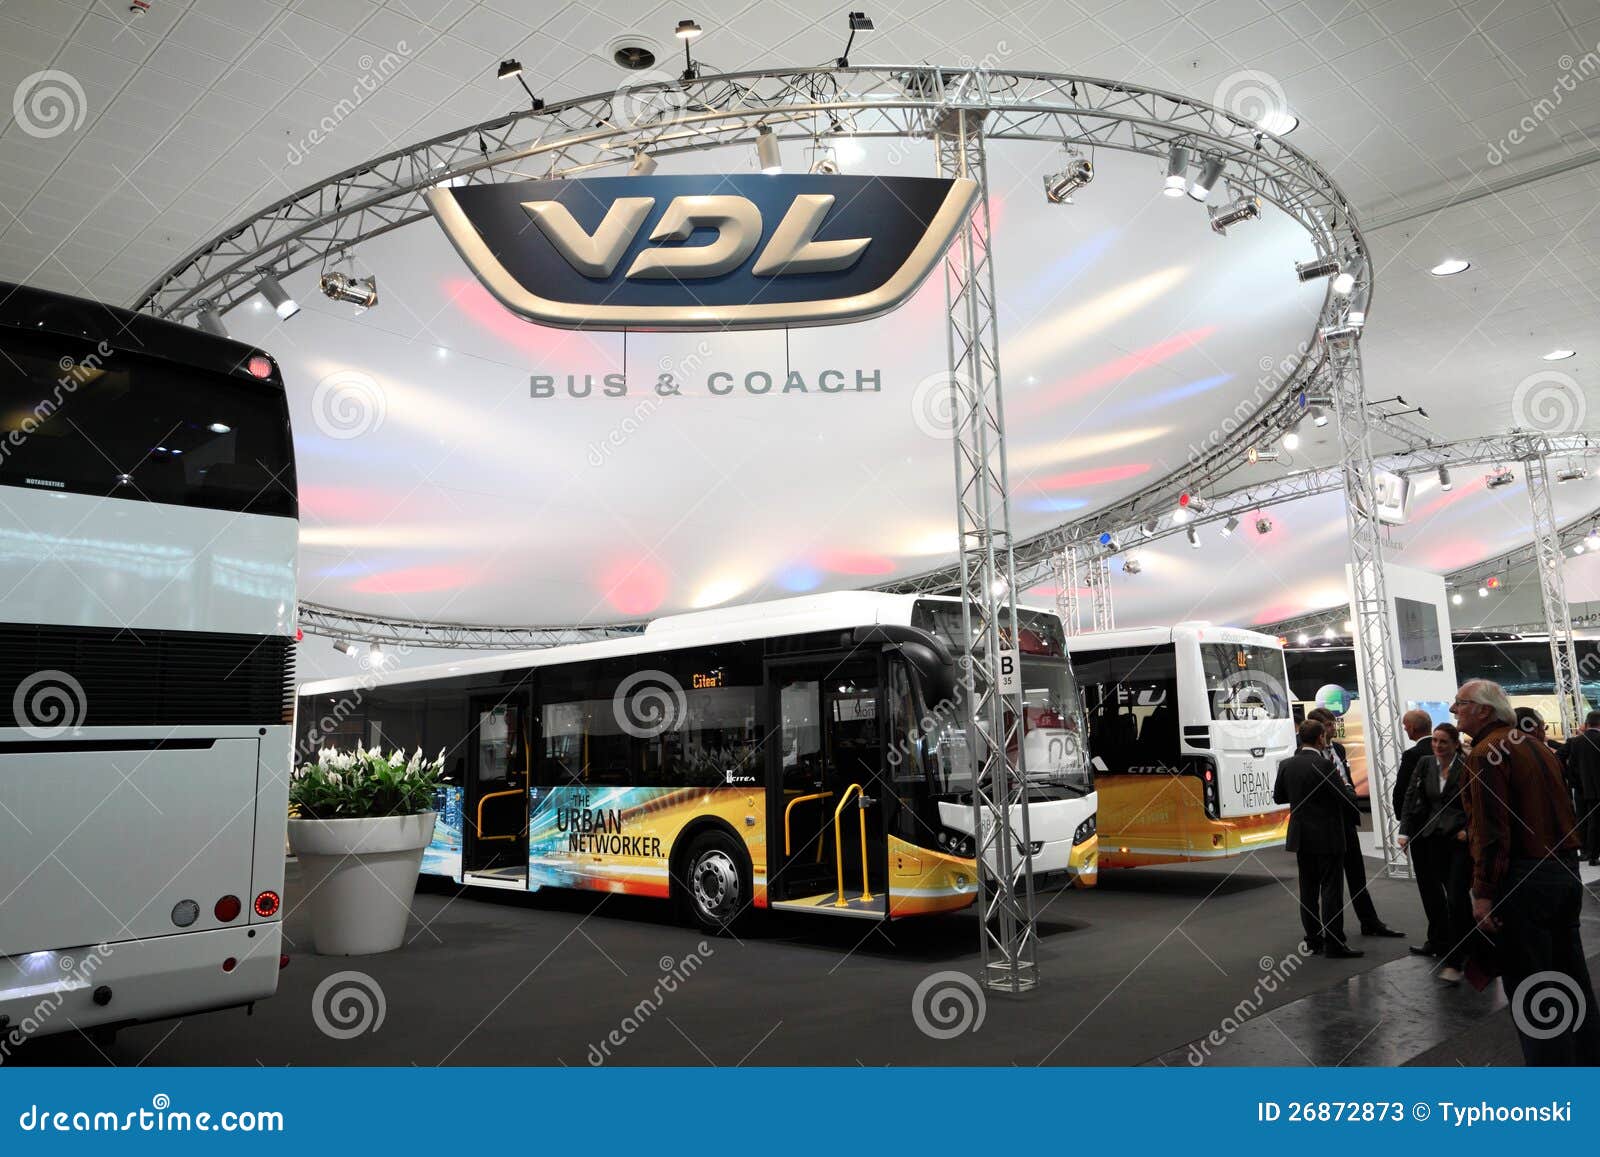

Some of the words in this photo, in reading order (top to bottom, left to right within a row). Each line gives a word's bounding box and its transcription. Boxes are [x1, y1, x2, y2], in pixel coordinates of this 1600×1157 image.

[520, 194, 872, 279] VDL
[530, 373, 627, 398] BUS
[654, 373, 683, 396] &
[707, 369, 881, 395] COACH
[1001, 656, 1014, 675] B
[1003, 677, 1013, 686] 35
[1128, 764, 1180, 775] CITEA
[1234, 772, 1271, 793] URBAN
[572, 794, 590, 807] THE
[557, 808, 622, 834] URBAN
[568, 832, 666, 858] NETWORKER.
